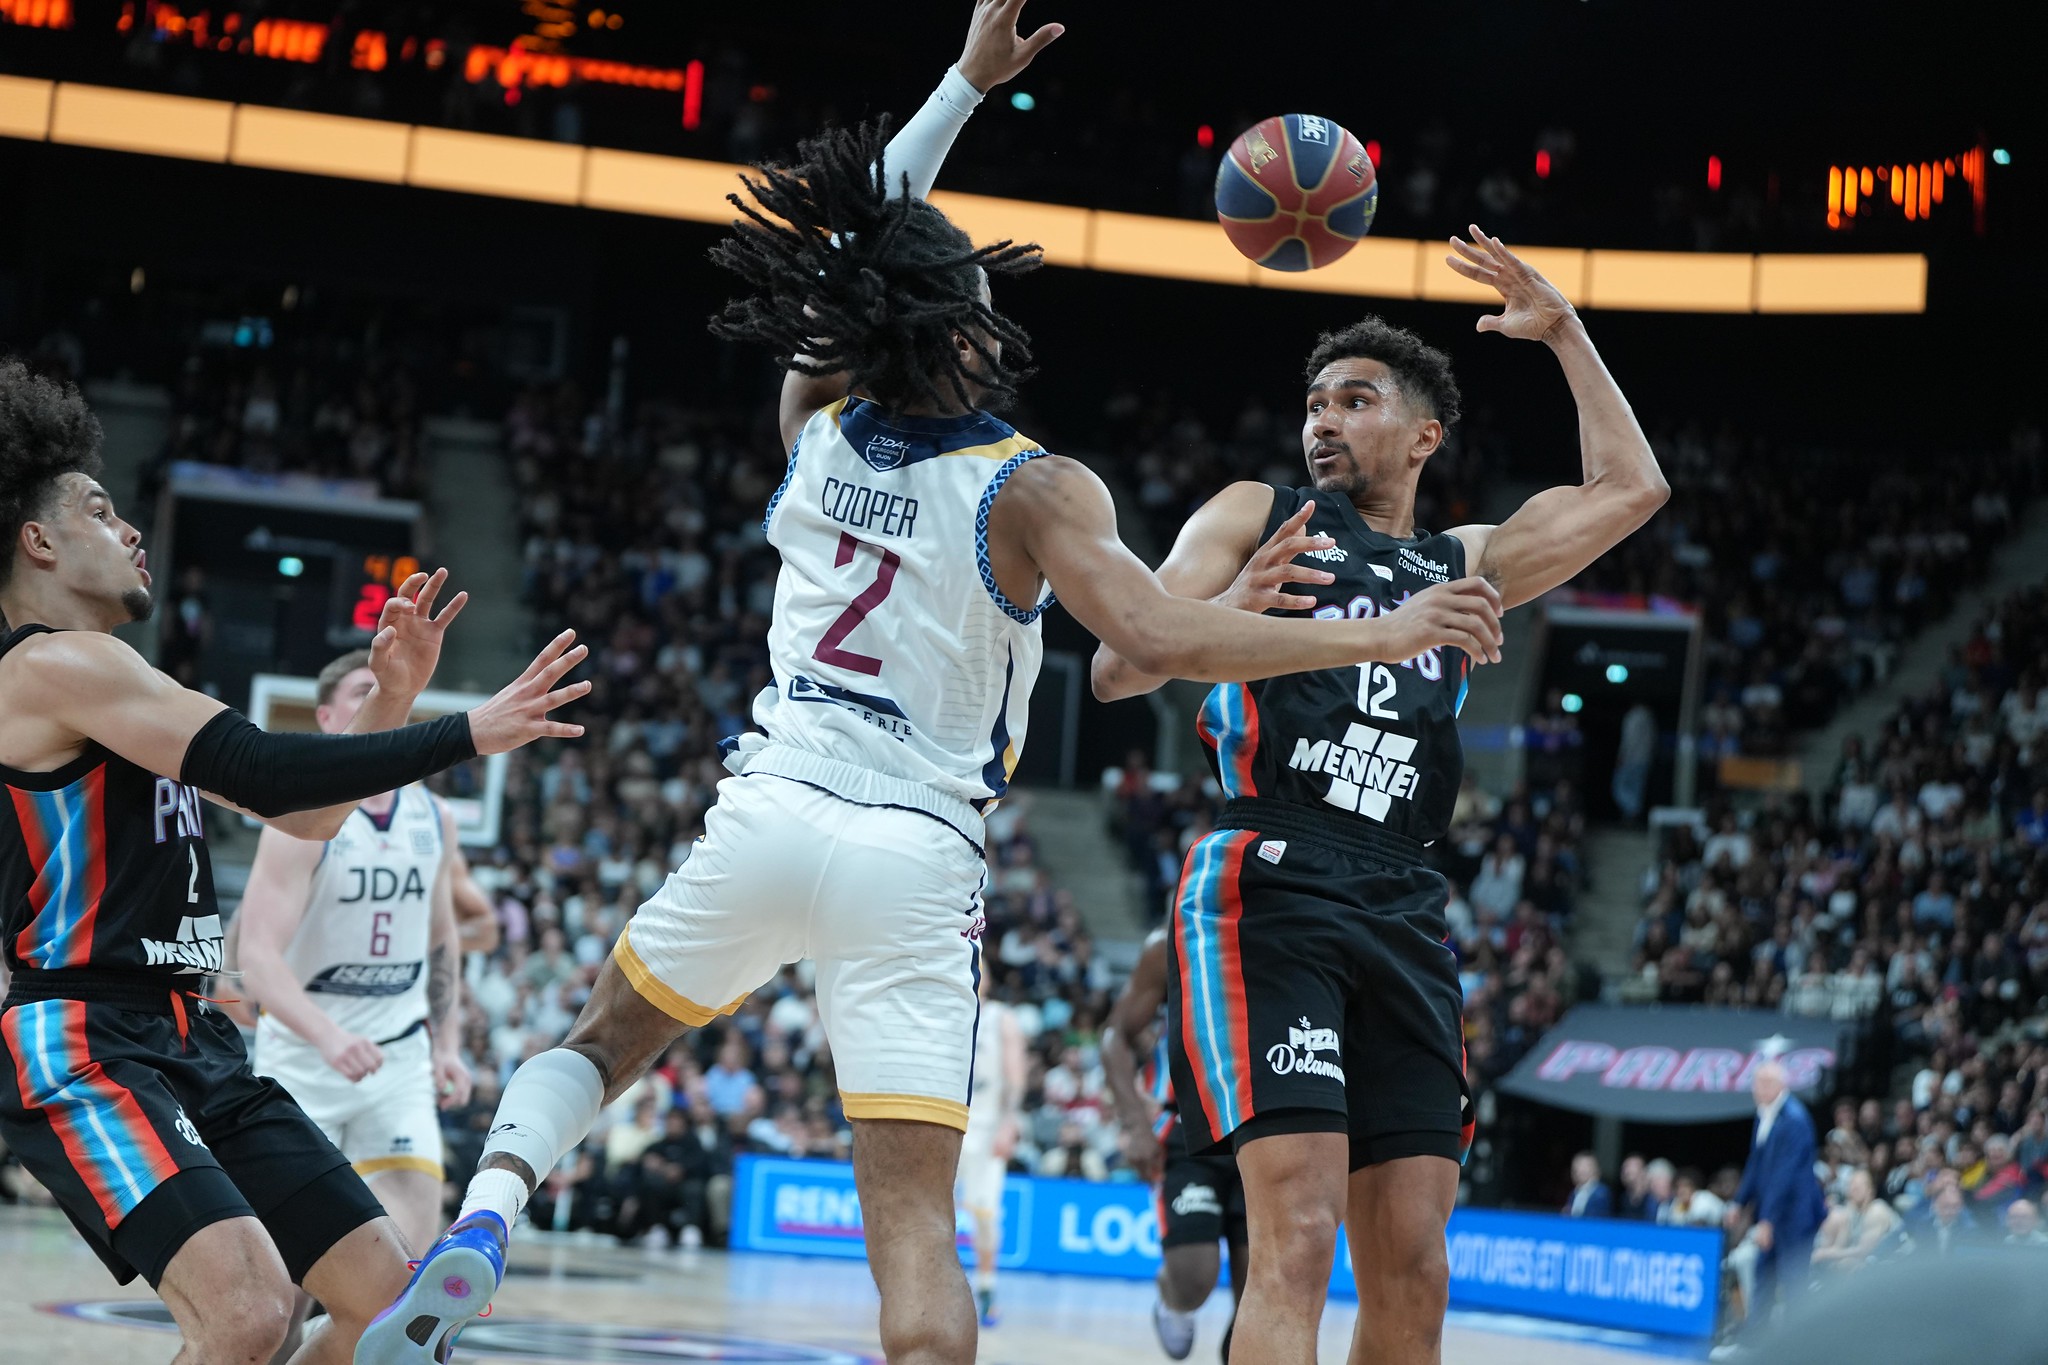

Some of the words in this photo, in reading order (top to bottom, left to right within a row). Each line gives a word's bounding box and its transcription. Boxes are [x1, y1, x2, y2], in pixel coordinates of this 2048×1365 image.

[822, 477, 919, 539] COOPER
[1398, 556, 1450, 583] COURTYARD
[1399, 548, 1449, 575] nutribullet
[812, 531, 901, 677] 2
[1356, 661, 1399, 720] 12
[338, 866, 425, 904] JDA
[141, 938, 224, 973] MENN
[370, 911, 392, 957] 6
[1447, 1231, 1535, 1290] OITURES
